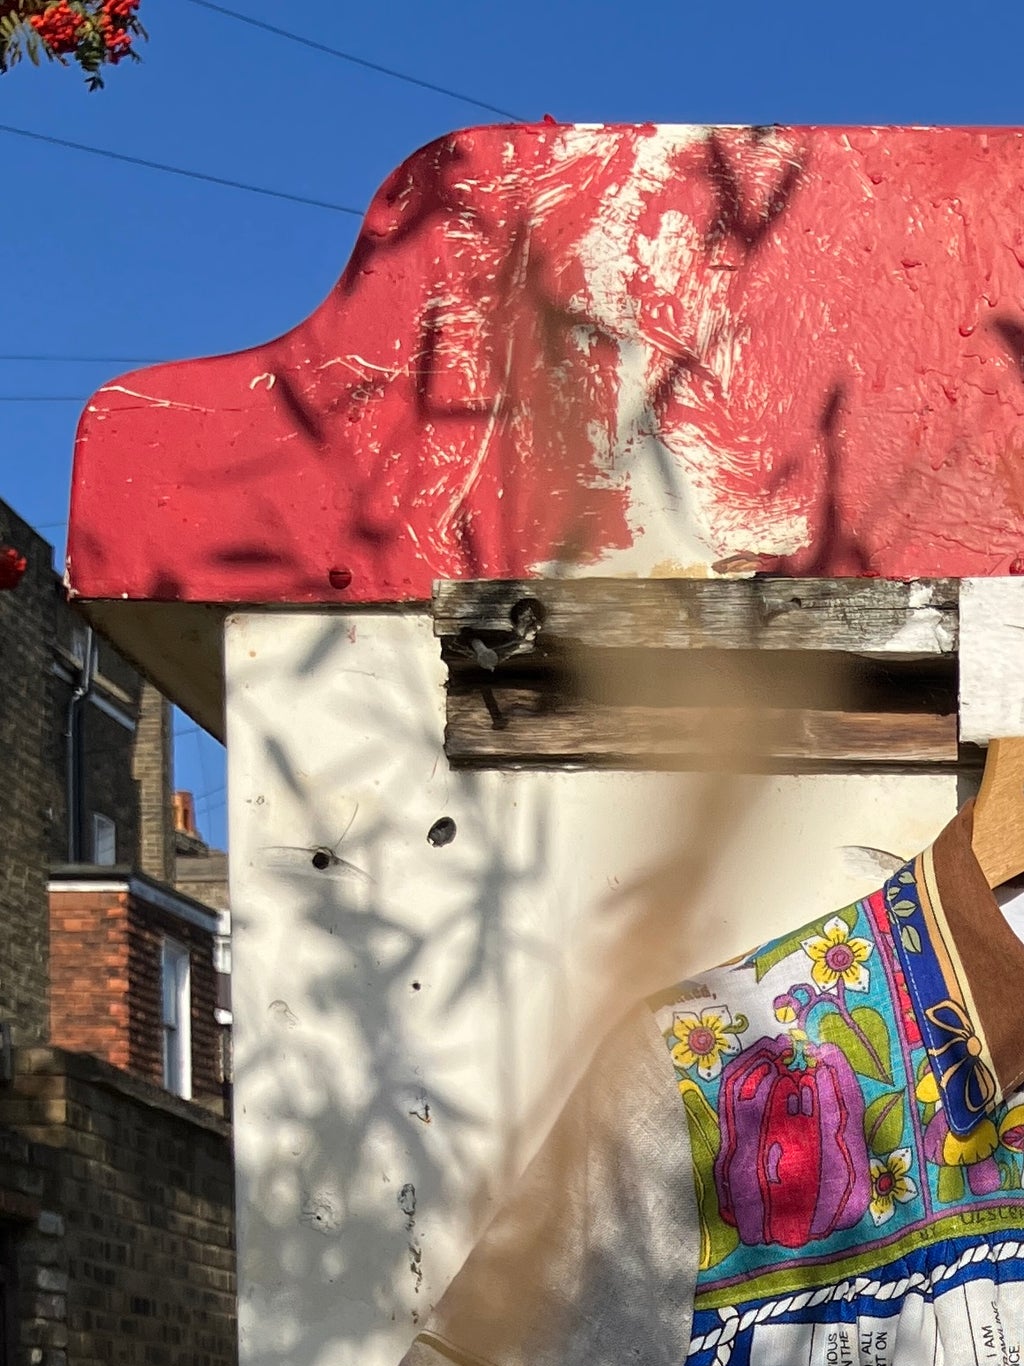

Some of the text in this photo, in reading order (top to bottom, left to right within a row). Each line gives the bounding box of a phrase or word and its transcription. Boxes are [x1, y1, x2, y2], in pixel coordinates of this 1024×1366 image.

[839, 1330, 851, 1357] THE
[861, 1331, 872, 1355] ALL
[875, 1331, 887, 1351] ON
[982, 1325, 995, 1348] AM
